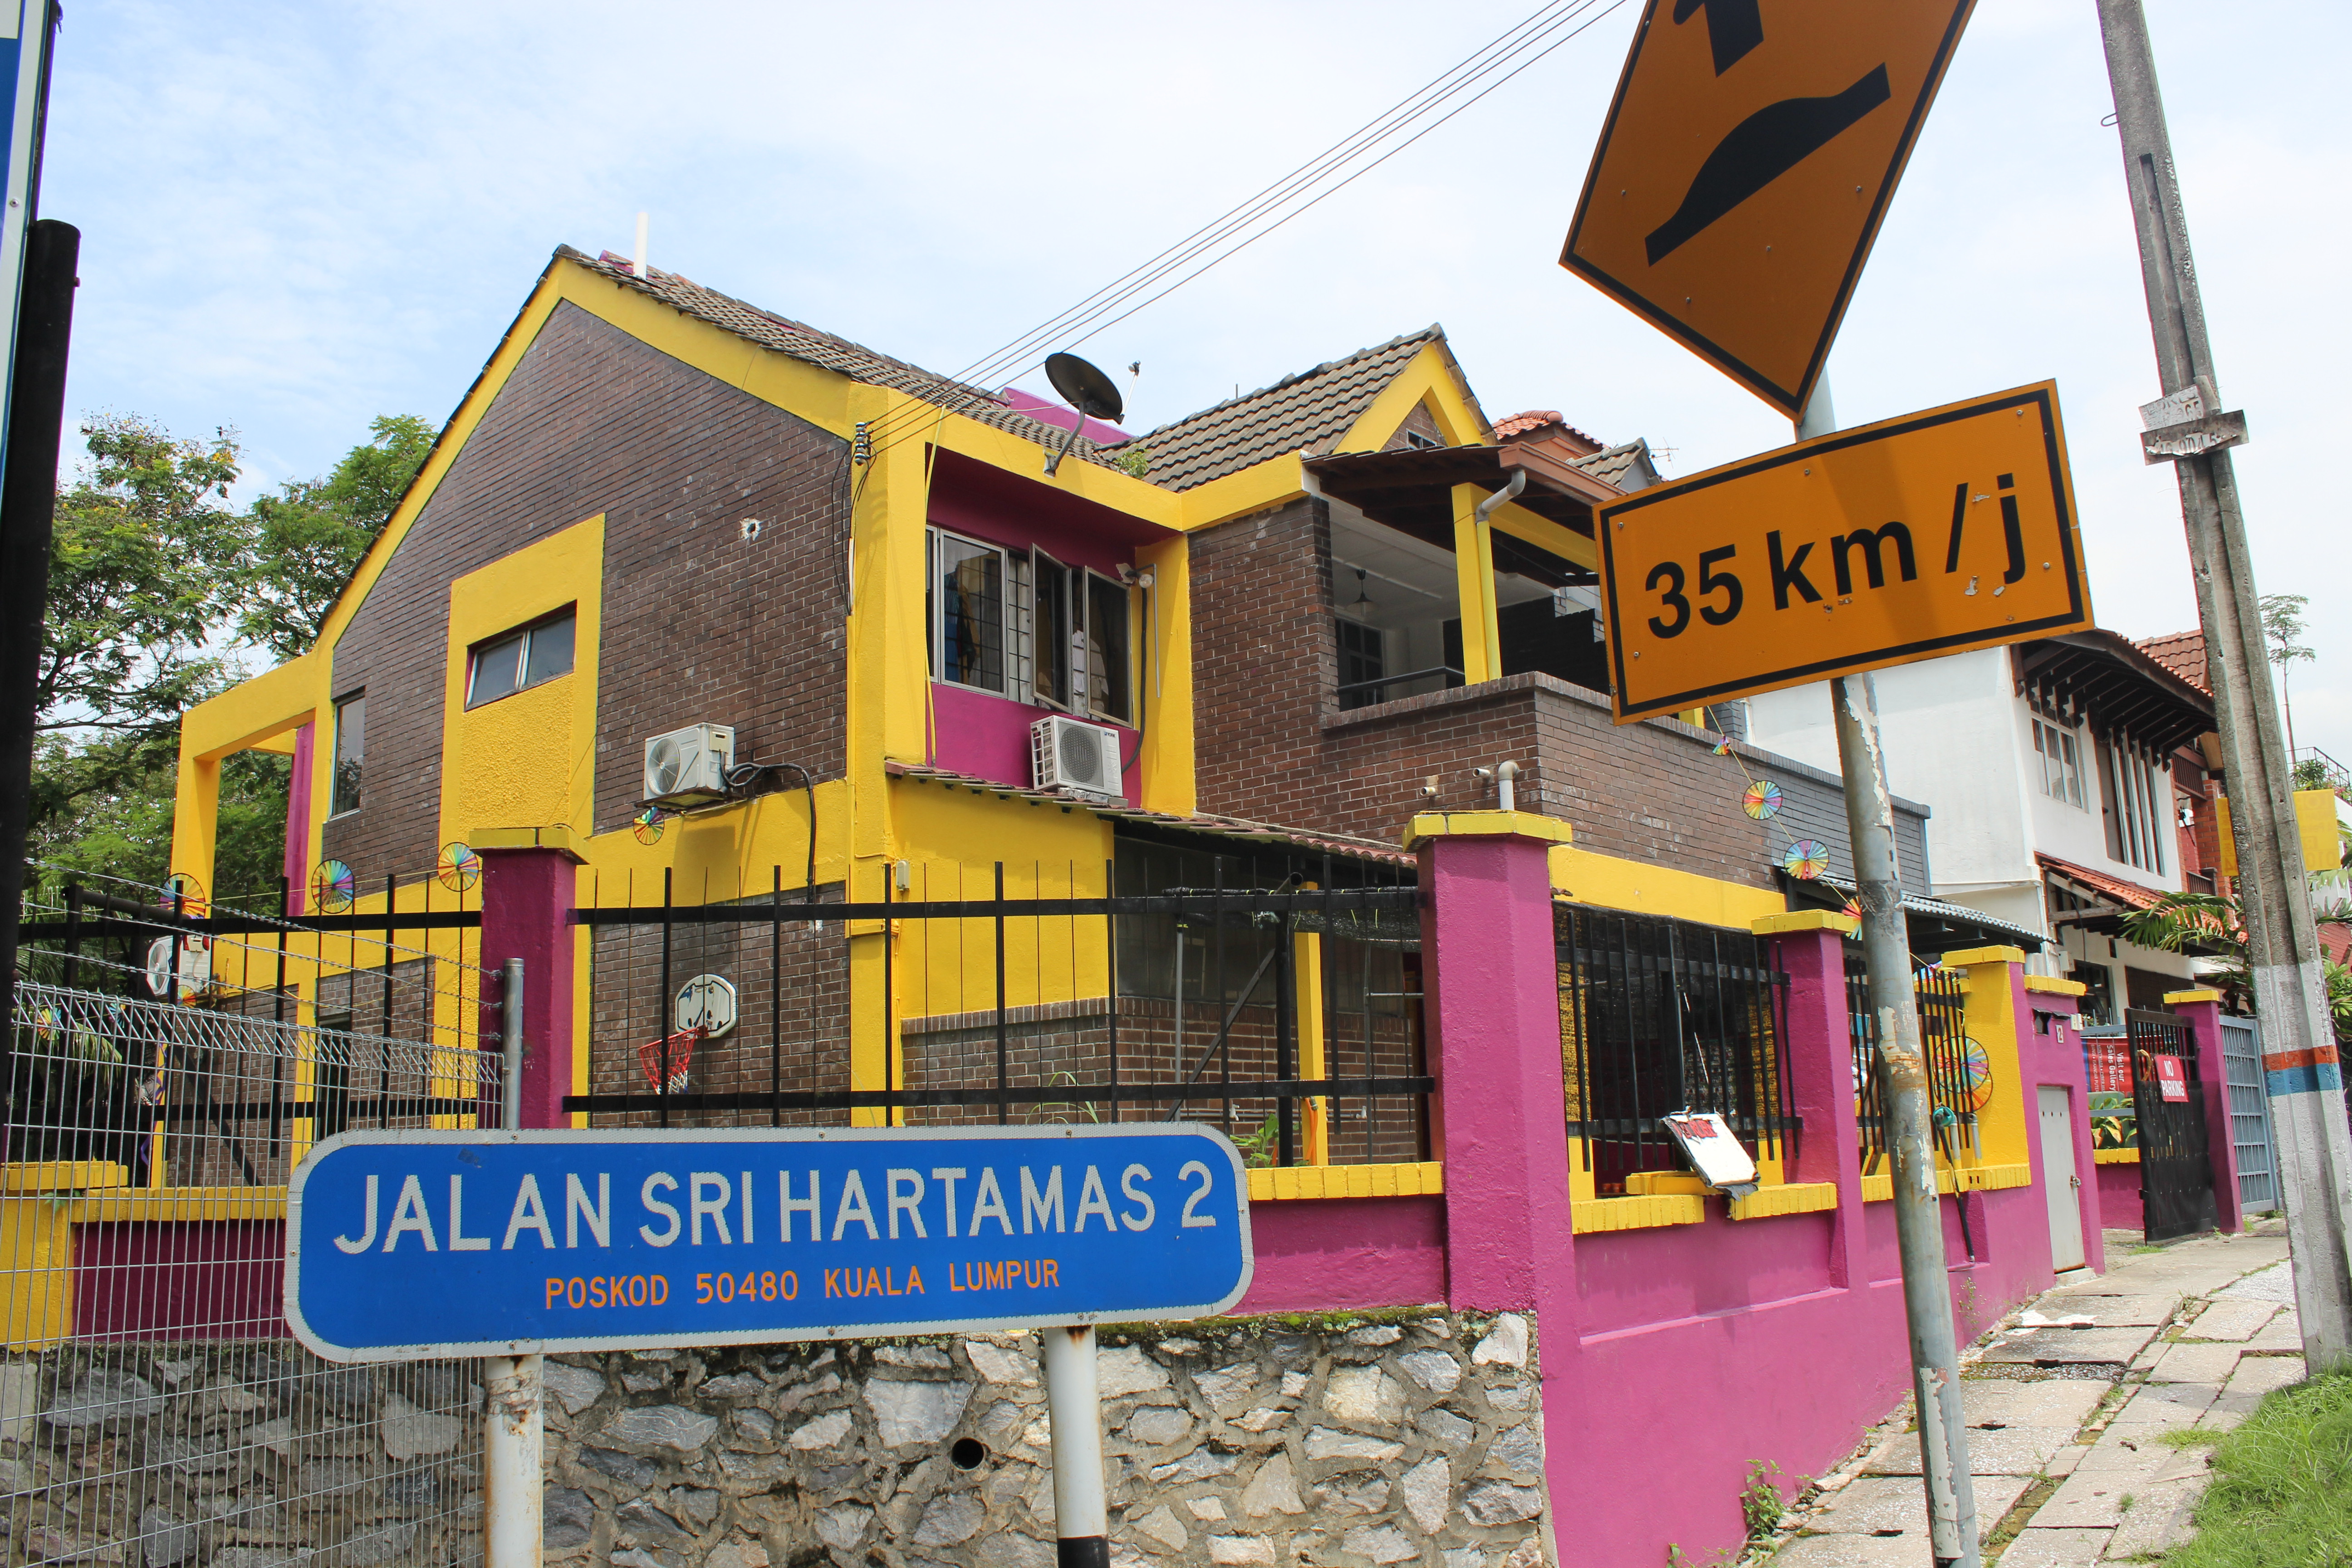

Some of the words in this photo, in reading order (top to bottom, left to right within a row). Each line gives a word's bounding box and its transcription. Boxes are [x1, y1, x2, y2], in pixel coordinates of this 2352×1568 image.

[1645, 544, 1744, 639] 35
[2107, 1045, 2115, 1063] Sales
[2164, 1060, 2174, 1077] NO
[2160, 1079, 2185, 1097] PARKING
[333, 1172, 610, 1254] JALAN
[638, 1171, 754, 1248] SRI
[779, 1163, 1156, 1243] HARTAMAS
[1177, 1160, 1217, 1229] 2
[546, 1274, 669, 1309] POSKOD
[697, 1270, 799, 1304] 50480
[825, 1265, 925, 1298] KUALA
[949, 1259, 1060, 1291] LUMPUR
